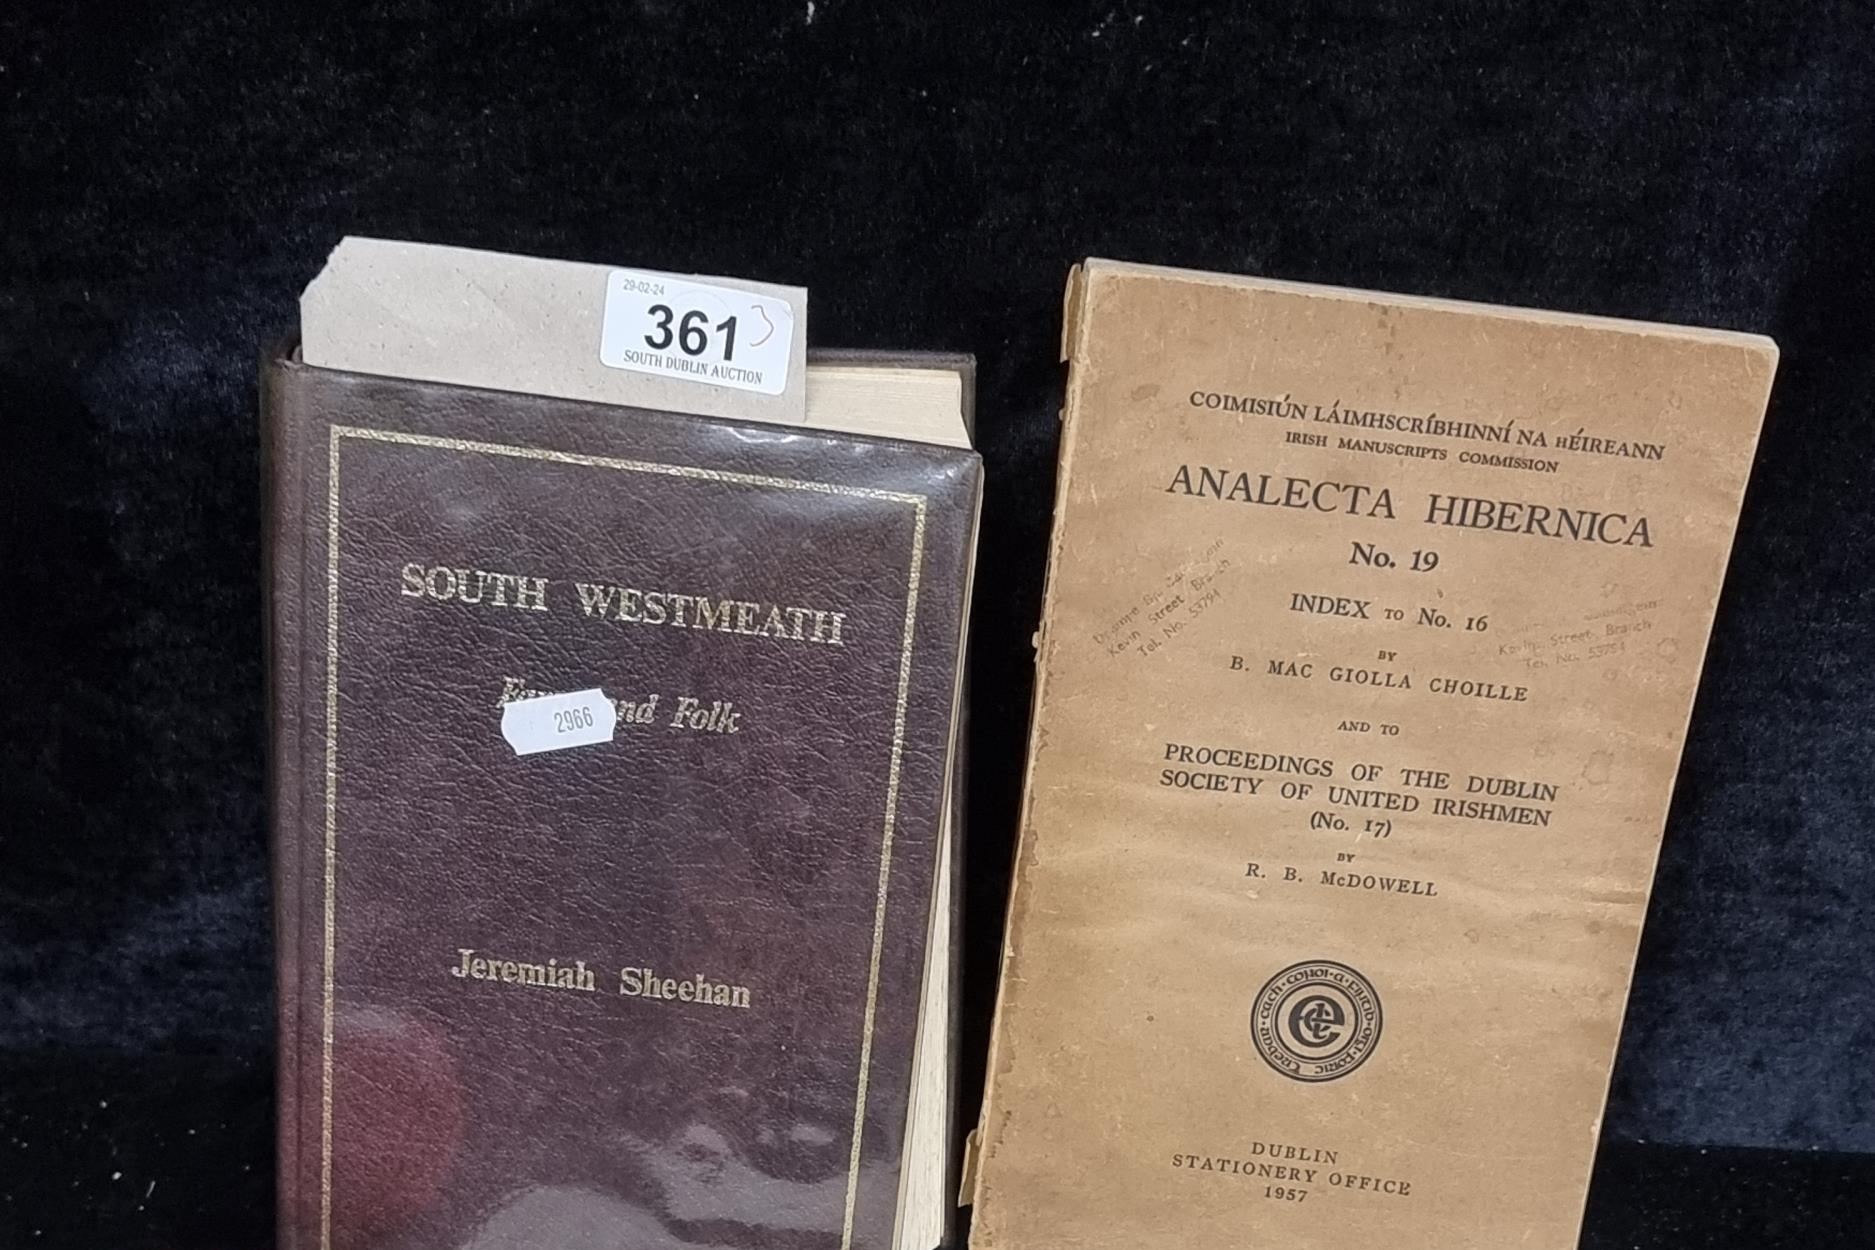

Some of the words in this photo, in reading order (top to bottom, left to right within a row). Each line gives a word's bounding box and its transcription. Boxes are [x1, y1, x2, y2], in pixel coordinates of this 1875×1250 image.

[623, 279, 666, 297] 29-02-24
[643, 304, 739, 362] 361
[623, 350, 664, 369] SOUTH
[666, 356, 710, 377] DUBLIN
[710, 365, 764, 386] AUCTION
[1516, 416, 1548, 448] NA
[1284, 430, 1329, 448] IRISH
[1337, 437, 1449, 461] MANUSCRIPTS
[1458, 451, 1561, 473] COMMISSION
[1166, 464, 1396, 520] ANALECTA
[1423, 493, 1654, 548] HIBERNICA
[1348, 541, 1397, 569] No.
[1409, 549, 1440, 573] 19
[401, 563, 550, 613] SOUTH
[575, 583, 848, 647] WESTMEATH
[1148, 595, 1186, 626] Street
[1289, 592, 1372, 620] INDEX
[1383, 607, 1405, 621] TO
[1416, 606, 1452, 629] No.
[1465, 614, 1489, 632] 16
[1377, 650, 1398, 662] BY
[1229, 655, 1251, 673] B.
[1266, 659, 1313, 679] MAC
[1329, 666, 1412, 690] GIOLLA
[1429, 677, 1529, 702] CHOILLE
[553, 706, 595, 734] 2966
[669, 696, 743, 735] Folk
[1336, 720, 1372, 733] AND
[1379, 723, 1400, 737] TO
[1163, 742, 1334, 778] PROCEEDINGS
[1350, 763, 1384, 782] OF
[1399, 768, 1451, 790] THE
[1465, 775, 1561, 803] DUBLIN
[1159, 768, 1265, 795] SOCIETY
[1280, 781, 1314, 801] OF
[1328, 785, 1420, 813] UNITED
[1431, 797, 1553, 827] IRISHMEN
[1309, 810, 1350, 832] (No.
[1363, 818, 1392, 839] 17)
[1336, 852, 1357, 863] BY
[1244, 862, 1266, 879] R.
[1282, 866, 1304, 883] B.
[1319, 870, 1438, 897] McDOWELL
[451, 948, 597, 993] Jeremiah
[619, 966, 751, 1010] Sheehan
[1250, 1141, 1339, 1165] DUBLIN
[1172, 1153, 1318, 1184] STATIONERY
[1328, 1172, 1411, 1197] OFFICE
[1263, 1185, 1309, 1203] 1957
